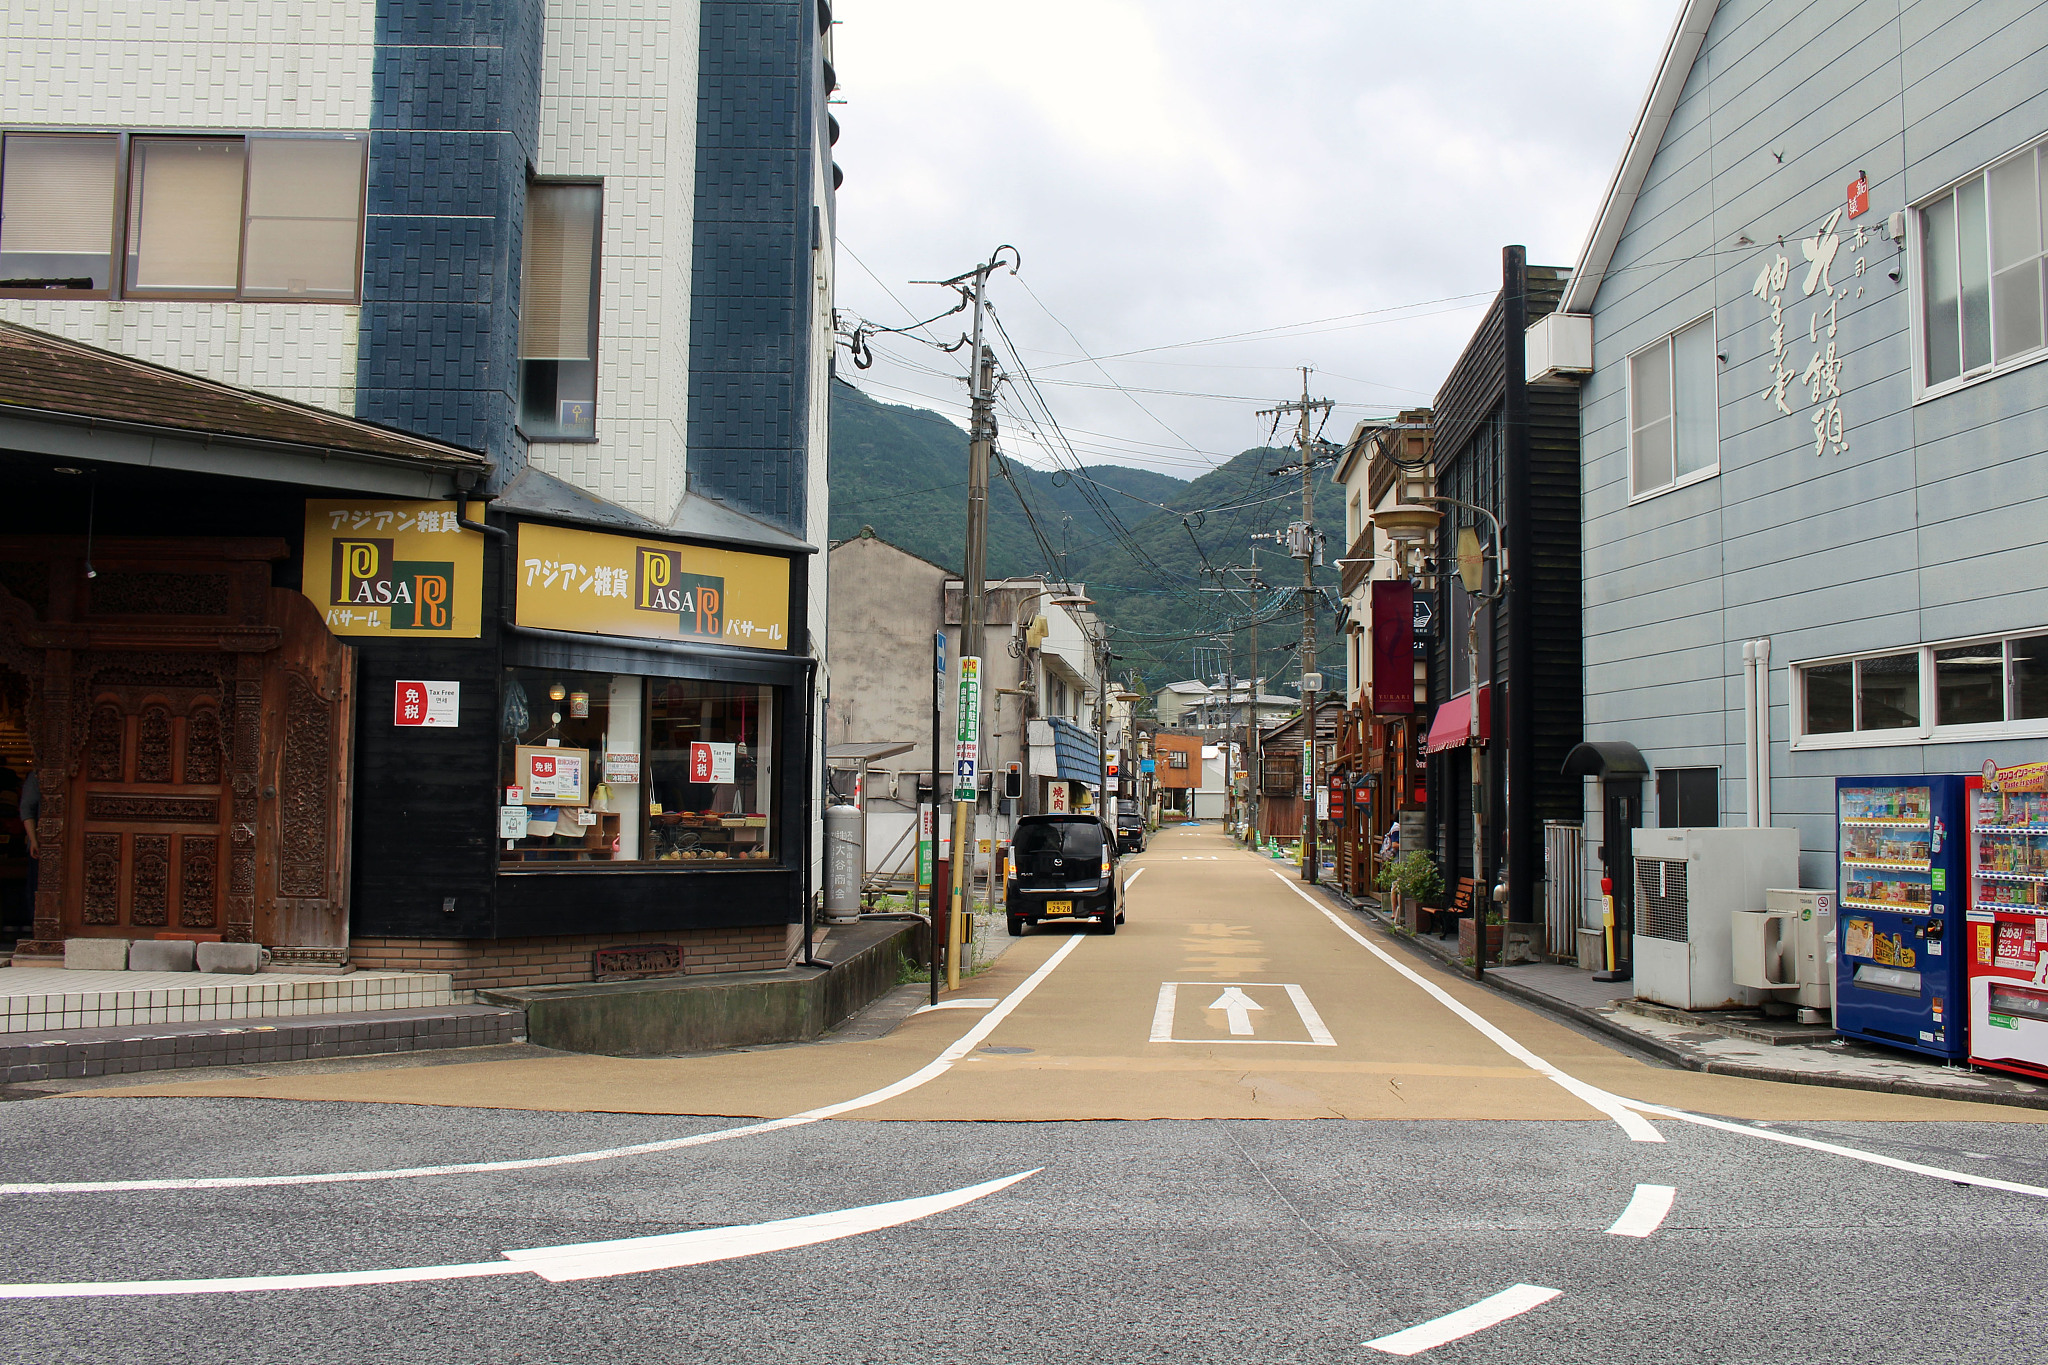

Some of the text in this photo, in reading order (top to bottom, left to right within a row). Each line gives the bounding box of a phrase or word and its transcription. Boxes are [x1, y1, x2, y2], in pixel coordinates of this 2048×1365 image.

[329, 510, 462, 533] アジアン雑貨
[337, 542, 447, 627] PASAR
[524, 558, 629, 599] アジアン雑貨
[640, 550, 719, 635] PASAR
[325, 609, 381, 627] パサール
[726, 619, 782, 641] パサール
[963, 661, 976, 669] NPC
[404, 688, 420, 719] 免税
[968, 683, 977, 740] 時間貸駐車場
[535, 761, 553, 773] 免税
[697, 749, 707, 777] 免税
[1108, 766, 1118, 775] P
[2004, 780, 2019, 789] Taste
[1053, 786, 1064, 811] 焼肉
[1999, 927, 2023, 940] ためる!
[1998, 944, 2021, 958] もらう!
